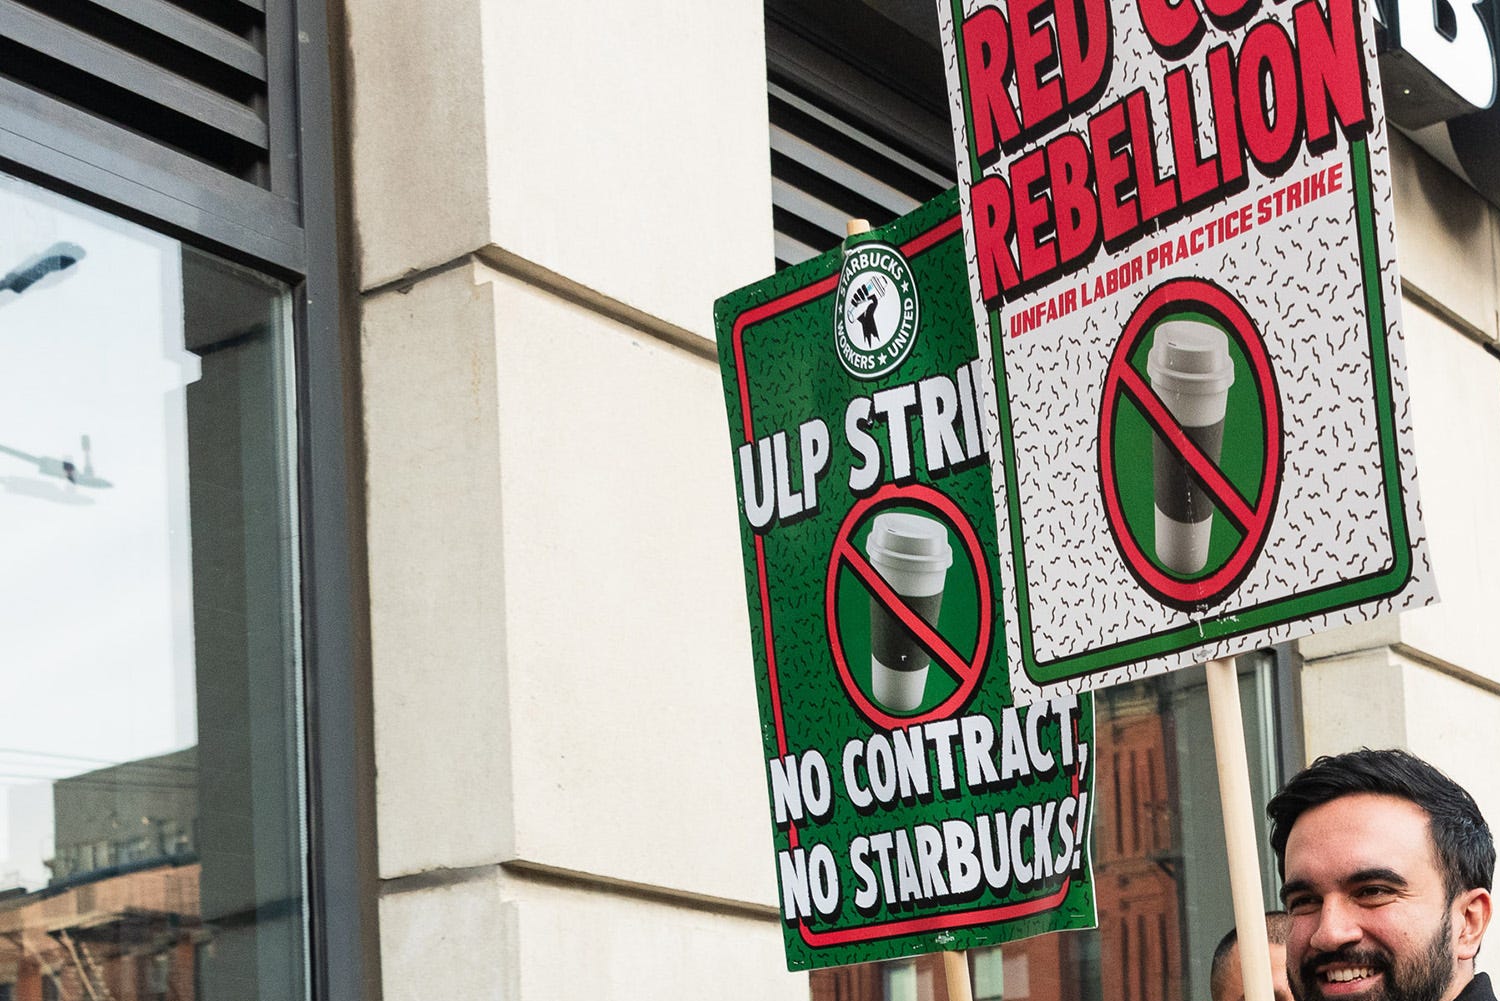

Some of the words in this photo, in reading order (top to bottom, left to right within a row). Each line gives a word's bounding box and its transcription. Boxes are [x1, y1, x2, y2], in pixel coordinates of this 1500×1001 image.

[962, 0, 1110, 161] RED
[970, 0, 1369, 304] REBELLION
[839, 251, 904, 298] STARBUCKS
[1009, 287, 1077, 339] UNFAIR
[1081, 259, 1144, 308] LABOR
[1147, 207, 1253, 276] PRACTICE
[1257, 162, 1344, 229] STRIKE
[836, 321, 876, 371] WORKERS
[886, 296, 915, 360] UNITED
[738, 417, 831, 530] ULP
[844, 358, 991, 492] STRI
[770, 750, 832, 826] NO
[843, 694, 1089, 809] CONTRACT,
[779, 844, 839, 920] NO
[850, 792, 1089, 909] STARBUCKS!
